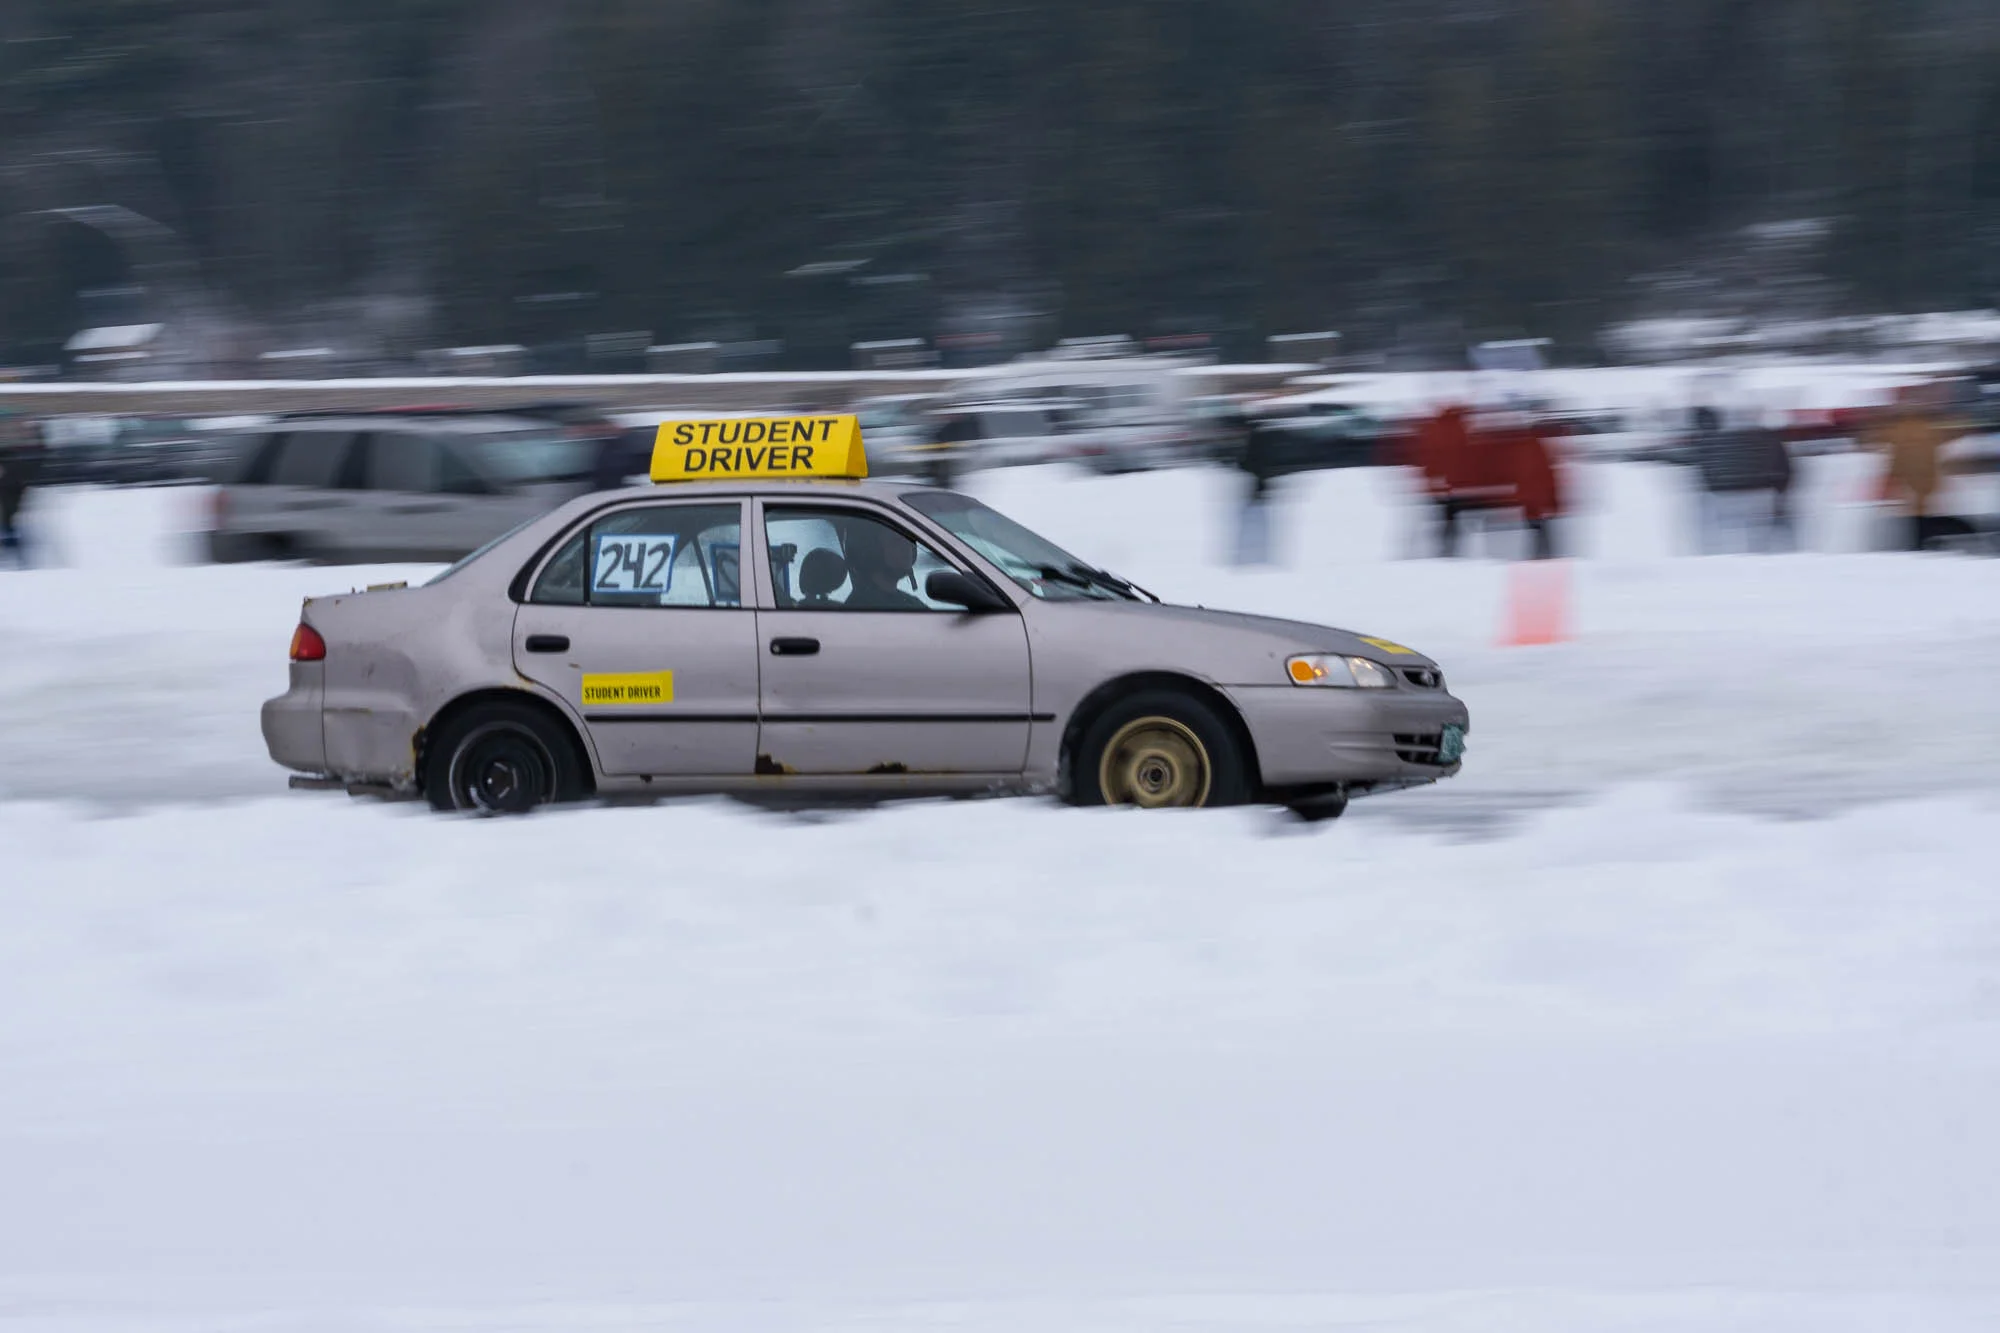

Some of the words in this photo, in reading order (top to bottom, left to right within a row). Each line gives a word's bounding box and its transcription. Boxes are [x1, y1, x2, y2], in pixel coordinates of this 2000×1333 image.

[673, 419, 839, 446] STUDENT
[683, 446, 815, 473] DRIVER
[596, 542, 672, 589] 242
[584, 686, 624, 700] STUDENT
[627, 685, 662, 699] DRIVER
